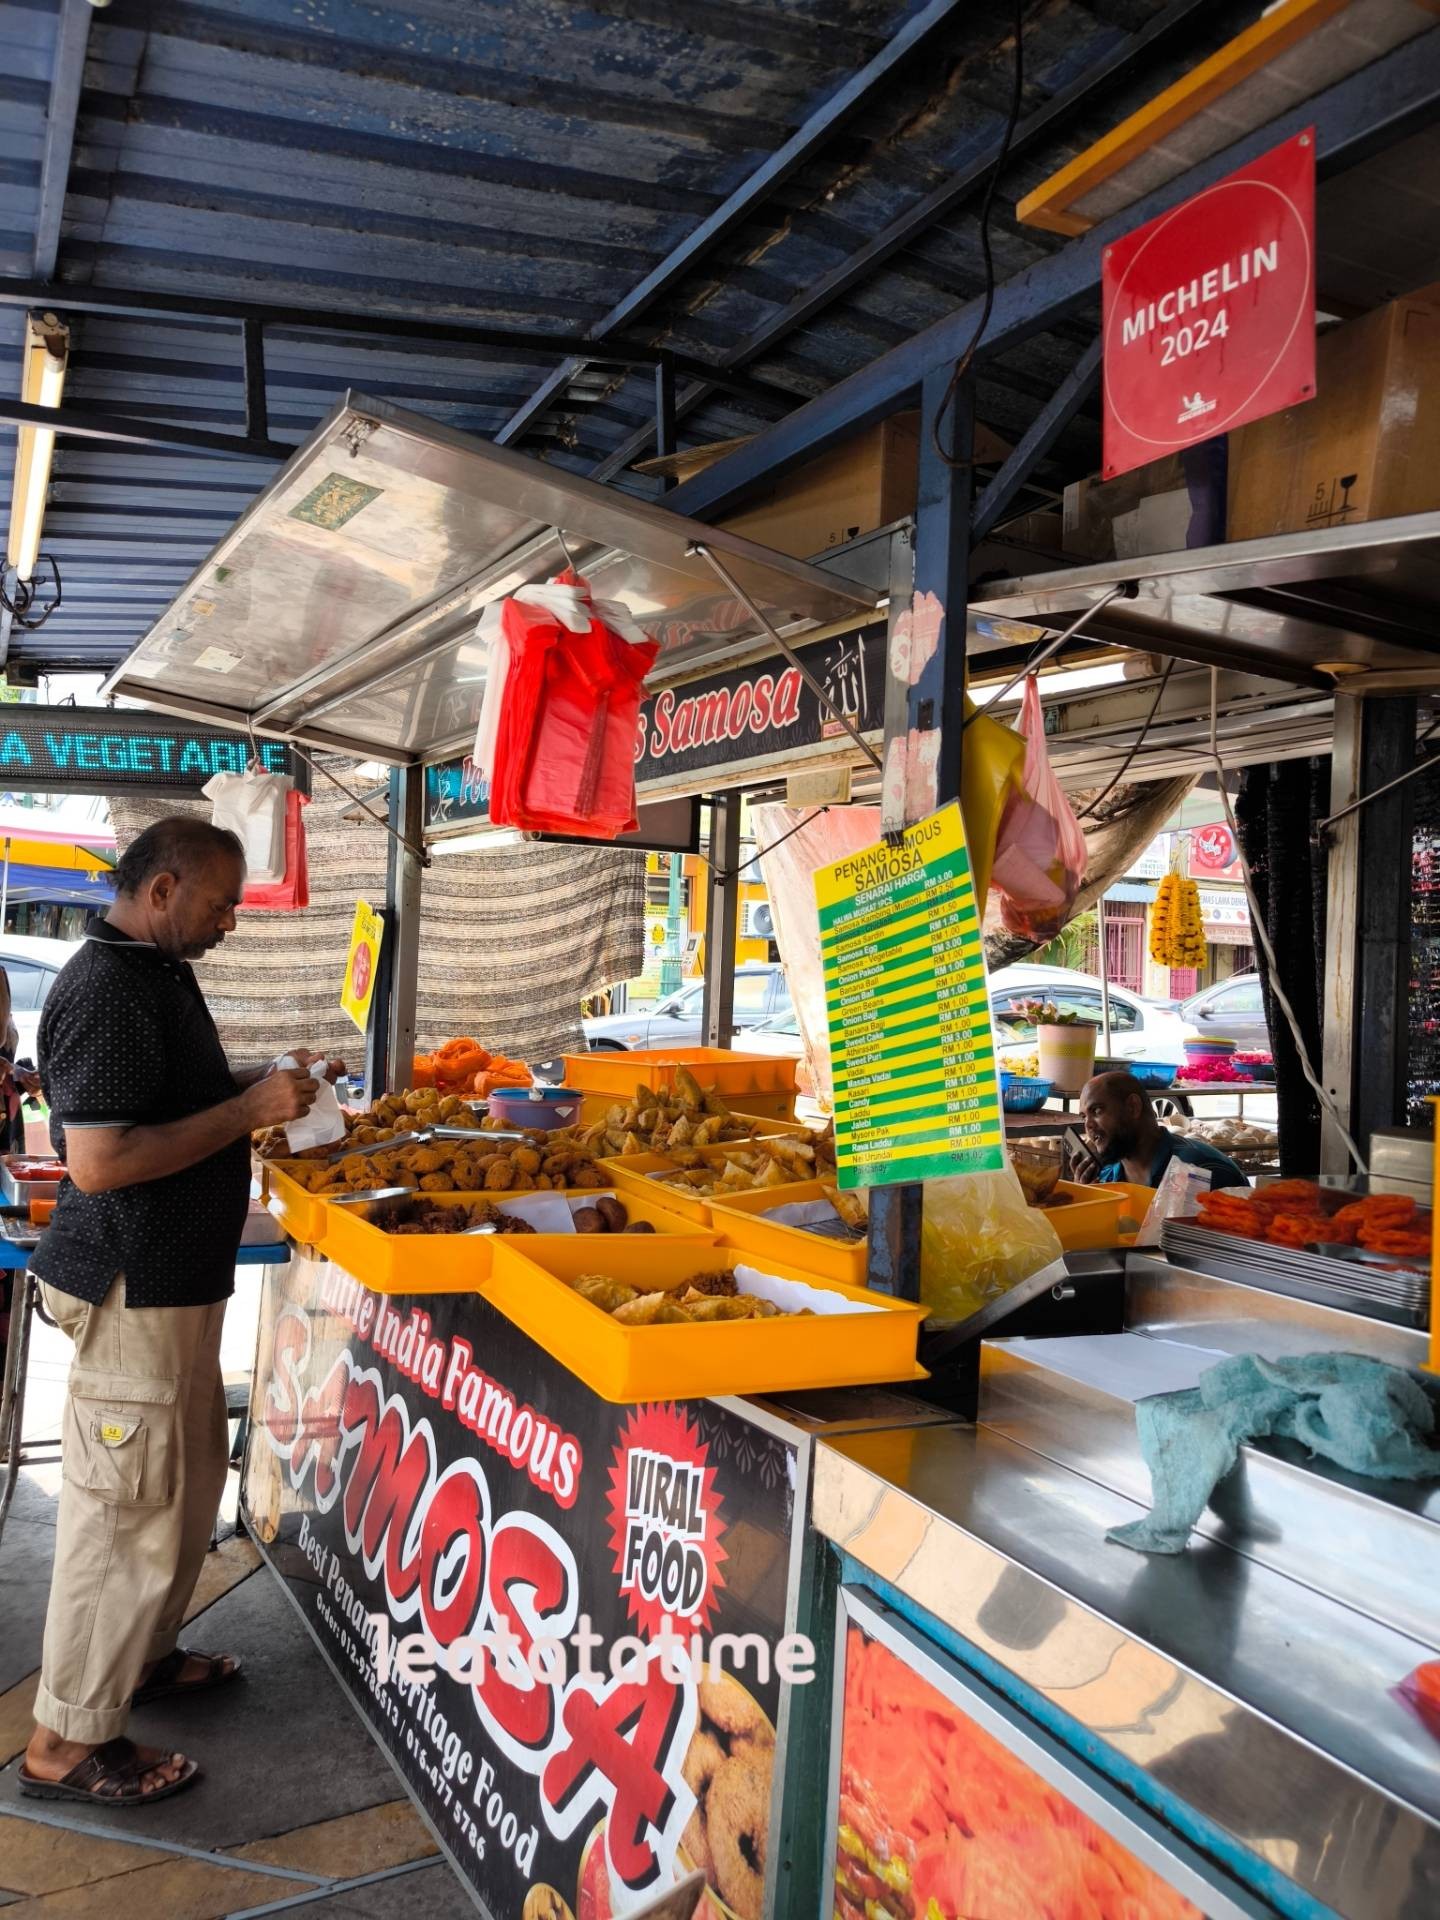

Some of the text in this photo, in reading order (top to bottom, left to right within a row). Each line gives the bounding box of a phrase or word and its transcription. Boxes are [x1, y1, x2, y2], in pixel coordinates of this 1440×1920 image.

[1122, 240, 1278, 346] MICHELIN
[1160, 308, 1229, 367] 2024
[650, 667, 803, 758] Samosa
[834, 819, 941, 883] PENANG FAMOUS
[854, 845, 923, 893] SAMOSA
[854, 866, 926, 907] SENARAI HARGA
[924, 876, 937, 889] RM
[834, 918, 859, 935] Samosa
[860, 905, 891, 926] Kambing
[925, 887, 937, 899] RM
[835, 900, 957, 954] Samosa Sardin RM 1.50
[836, 947, 863, 965] Samosa
[864, 942, 878, 956] Egg
[929, 919, 942, 932] RM
[837, 958, 863, 974] Samosa
[868, 944, 902, 965] Vegetable
[930, 931, 942, 942] RM
[944, 924, 960, 937] 1.00
[838, 971, 858, 985] Onion
[931, 942, 944, 954] RM
[839, 947, 963, 996] Banana Ball RM 1.00
[840, 993, 860, 1006] Onion
[934, 965, 947, 977] RM
[948, 958, 965, 972] 1.00
[841, 1003, 861, 1017] Green
[935, 977, 948, 988] RM
[949, 971, 966, 983] 1.00
[842, 1013, 861, 1027] Onion
[936, 988, 949, 1000] RM
[950, 982, 967, 995] 1.00
[844, 1023, 868, 1038] Banana
[937, 1000, 950, 1012] RM
[951, 994, 968, 1007] 1.00
[844, 1005, 970, 1048] Sweet Cake RM 1.00
[939, 1023, 952, 1034] RM
[954, 1017, 971, 1029] 1.00
[846, 1055, 866, 1068] Sweet
[867, 1051, 881, 1063] Puri
[940, 1033, 954, 1045] RM
[941, 1044, 954, 1055] RM
[956, 1039, 973, 1051] 1.00
[942, 1055, 956, 1066] RM
[957, 1050, 974, 1063] 1.00
[943, 1066, 956, 1077] RM
[958, 1062, 975, 1074] 1.00
[848, 1073, 977, 1110] Candy RM 1.00
[849, 1085, 978, 1120] Laddu RM 1.00
[850, 1097, 979, 1130] Jalebi RM 1.00
[851, 1110, 980, 1142] Mysore Pak RM 1.00
[869, 1137, 892, 1149] Laddu
[948, 1125, 962, 1137] RM
[963, 1121, 981, 1133] 1.00
[949, 1138, 962, 1149] RM
[964, 1135, 982, 1146] 1.00
[951, 1151, 964, 1162] RM
[371, 1292, 445, 1392] India
[442, 1338, 580, 1504] Famous
[626, 1448, 705, 1538] VIRAL
[623, 1520, 706, 1616] FOOD
[267, 1305, 699, 1891] SAMOSA
[298, 1513, 328, 1579] Best
[473, 1757, 540, 1879] Food
[316, 1592, 341, 1640] Order:
[453, 1799, 486, 1861] 5786
